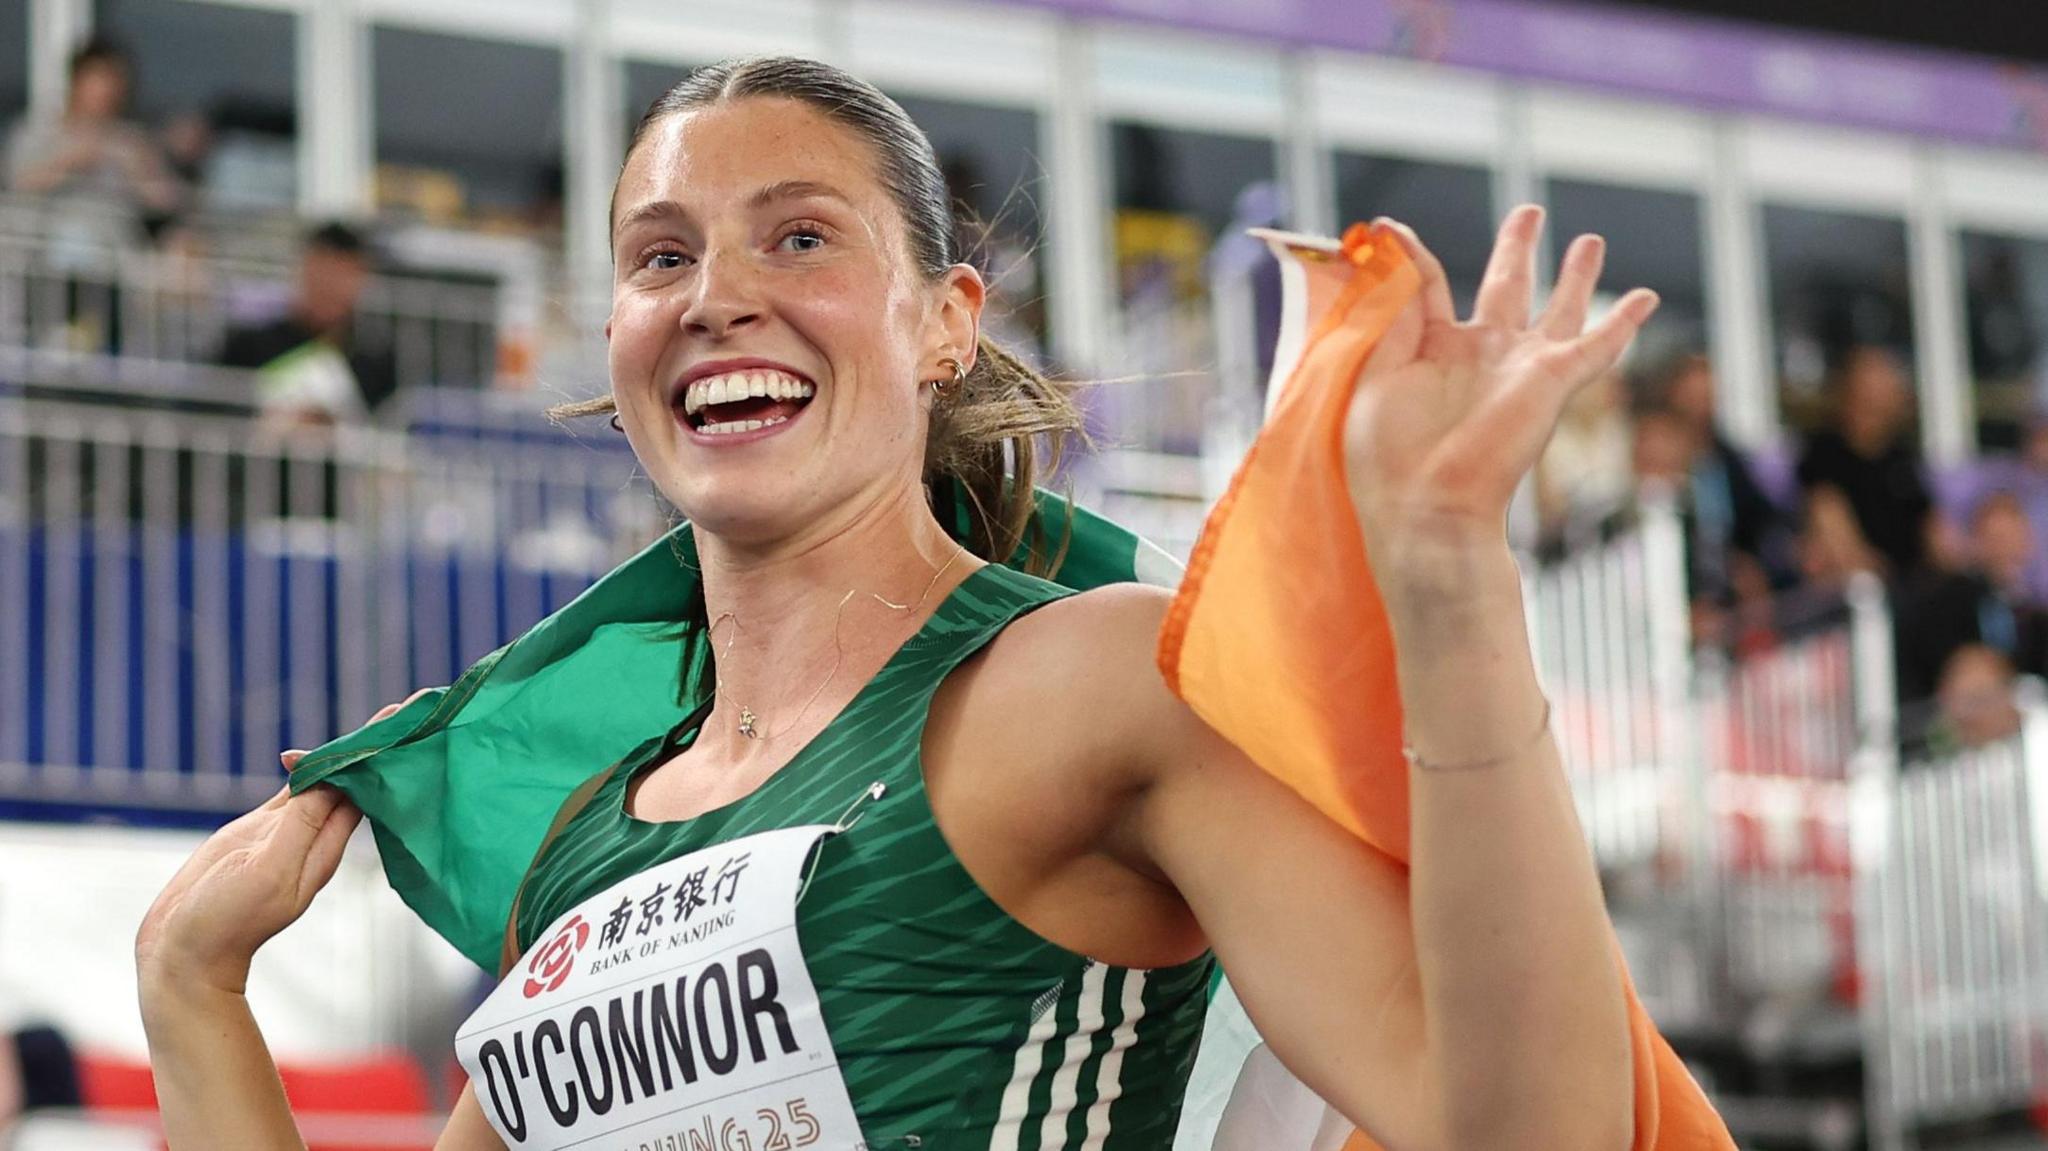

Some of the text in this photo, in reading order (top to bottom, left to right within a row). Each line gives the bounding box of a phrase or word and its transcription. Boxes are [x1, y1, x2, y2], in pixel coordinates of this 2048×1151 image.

[598, 852, 751, 950] 南京银行
[589, 910, 736, 975] BANK OF NANJING
[478, 948, 800, 1143] O'CONNOR
[757, 1098, 821, 1150] 25
